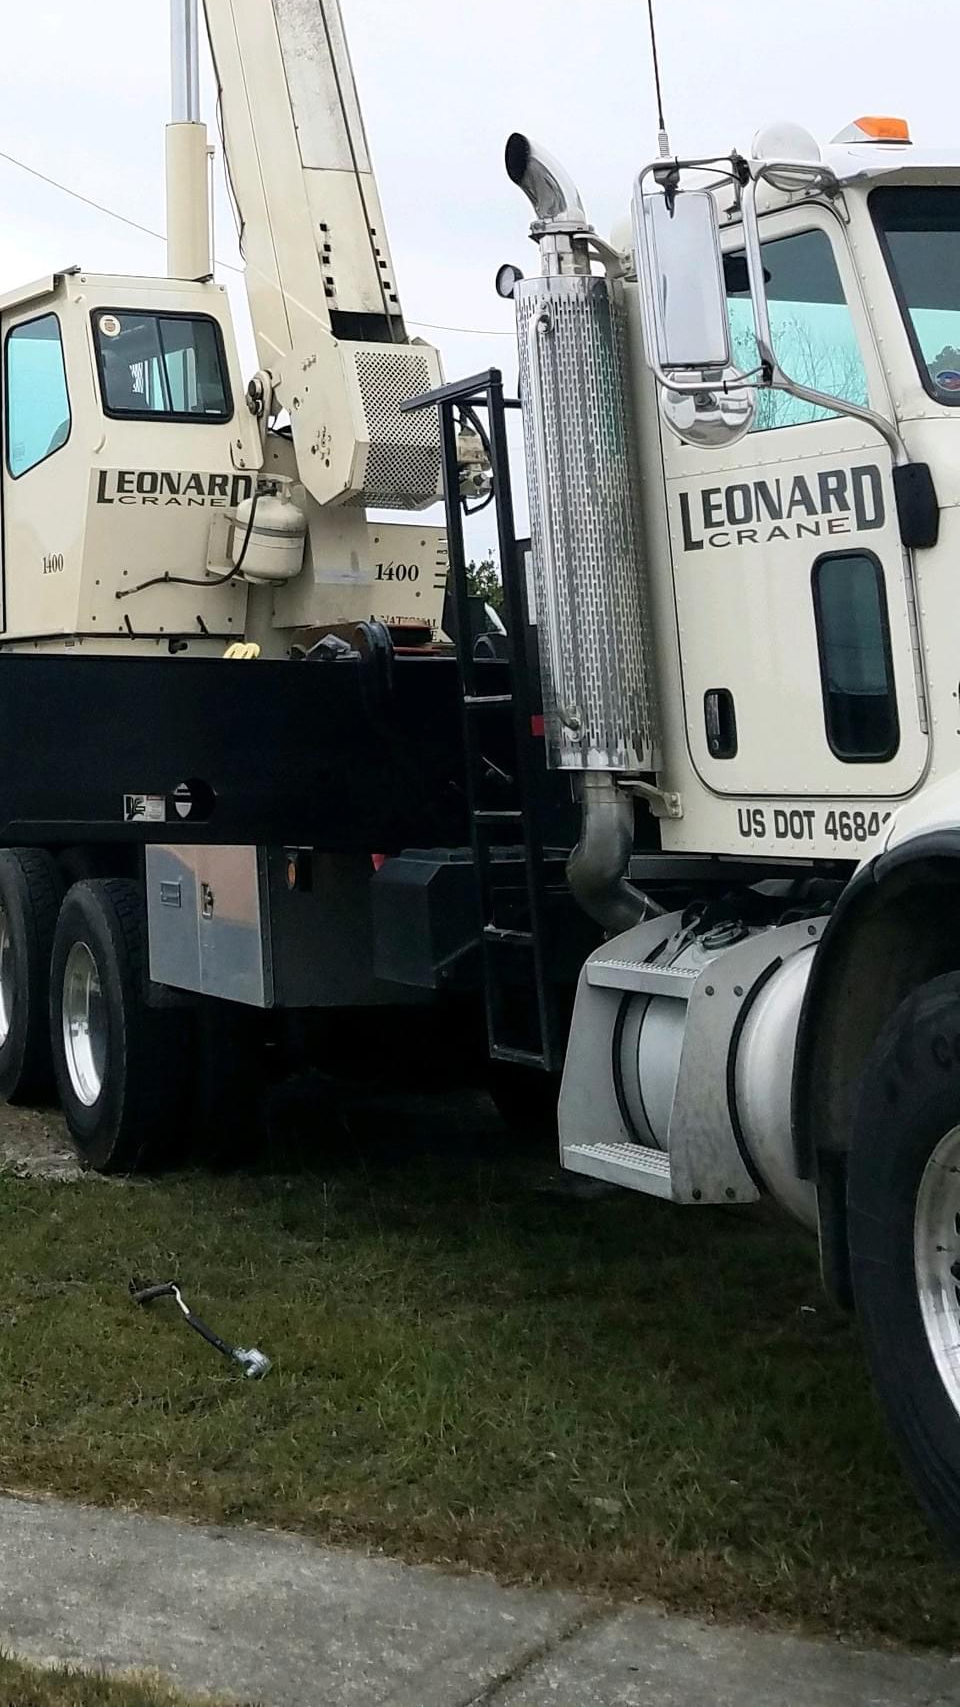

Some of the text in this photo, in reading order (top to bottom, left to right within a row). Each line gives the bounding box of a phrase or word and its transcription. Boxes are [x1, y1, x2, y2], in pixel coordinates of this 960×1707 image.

[96, 470, 253, 507] LEONARD
[118, 496, 227, 507] CRANE
[679, 464, 886, 552] LEONARD
[708, 517, 852, 548] CRANE
[42, 552, 64, 574] 1400
[374, 560, 420, 581] 1400
[738, 808, 766, 838] US
[774, 809, 816, 840] DOT
